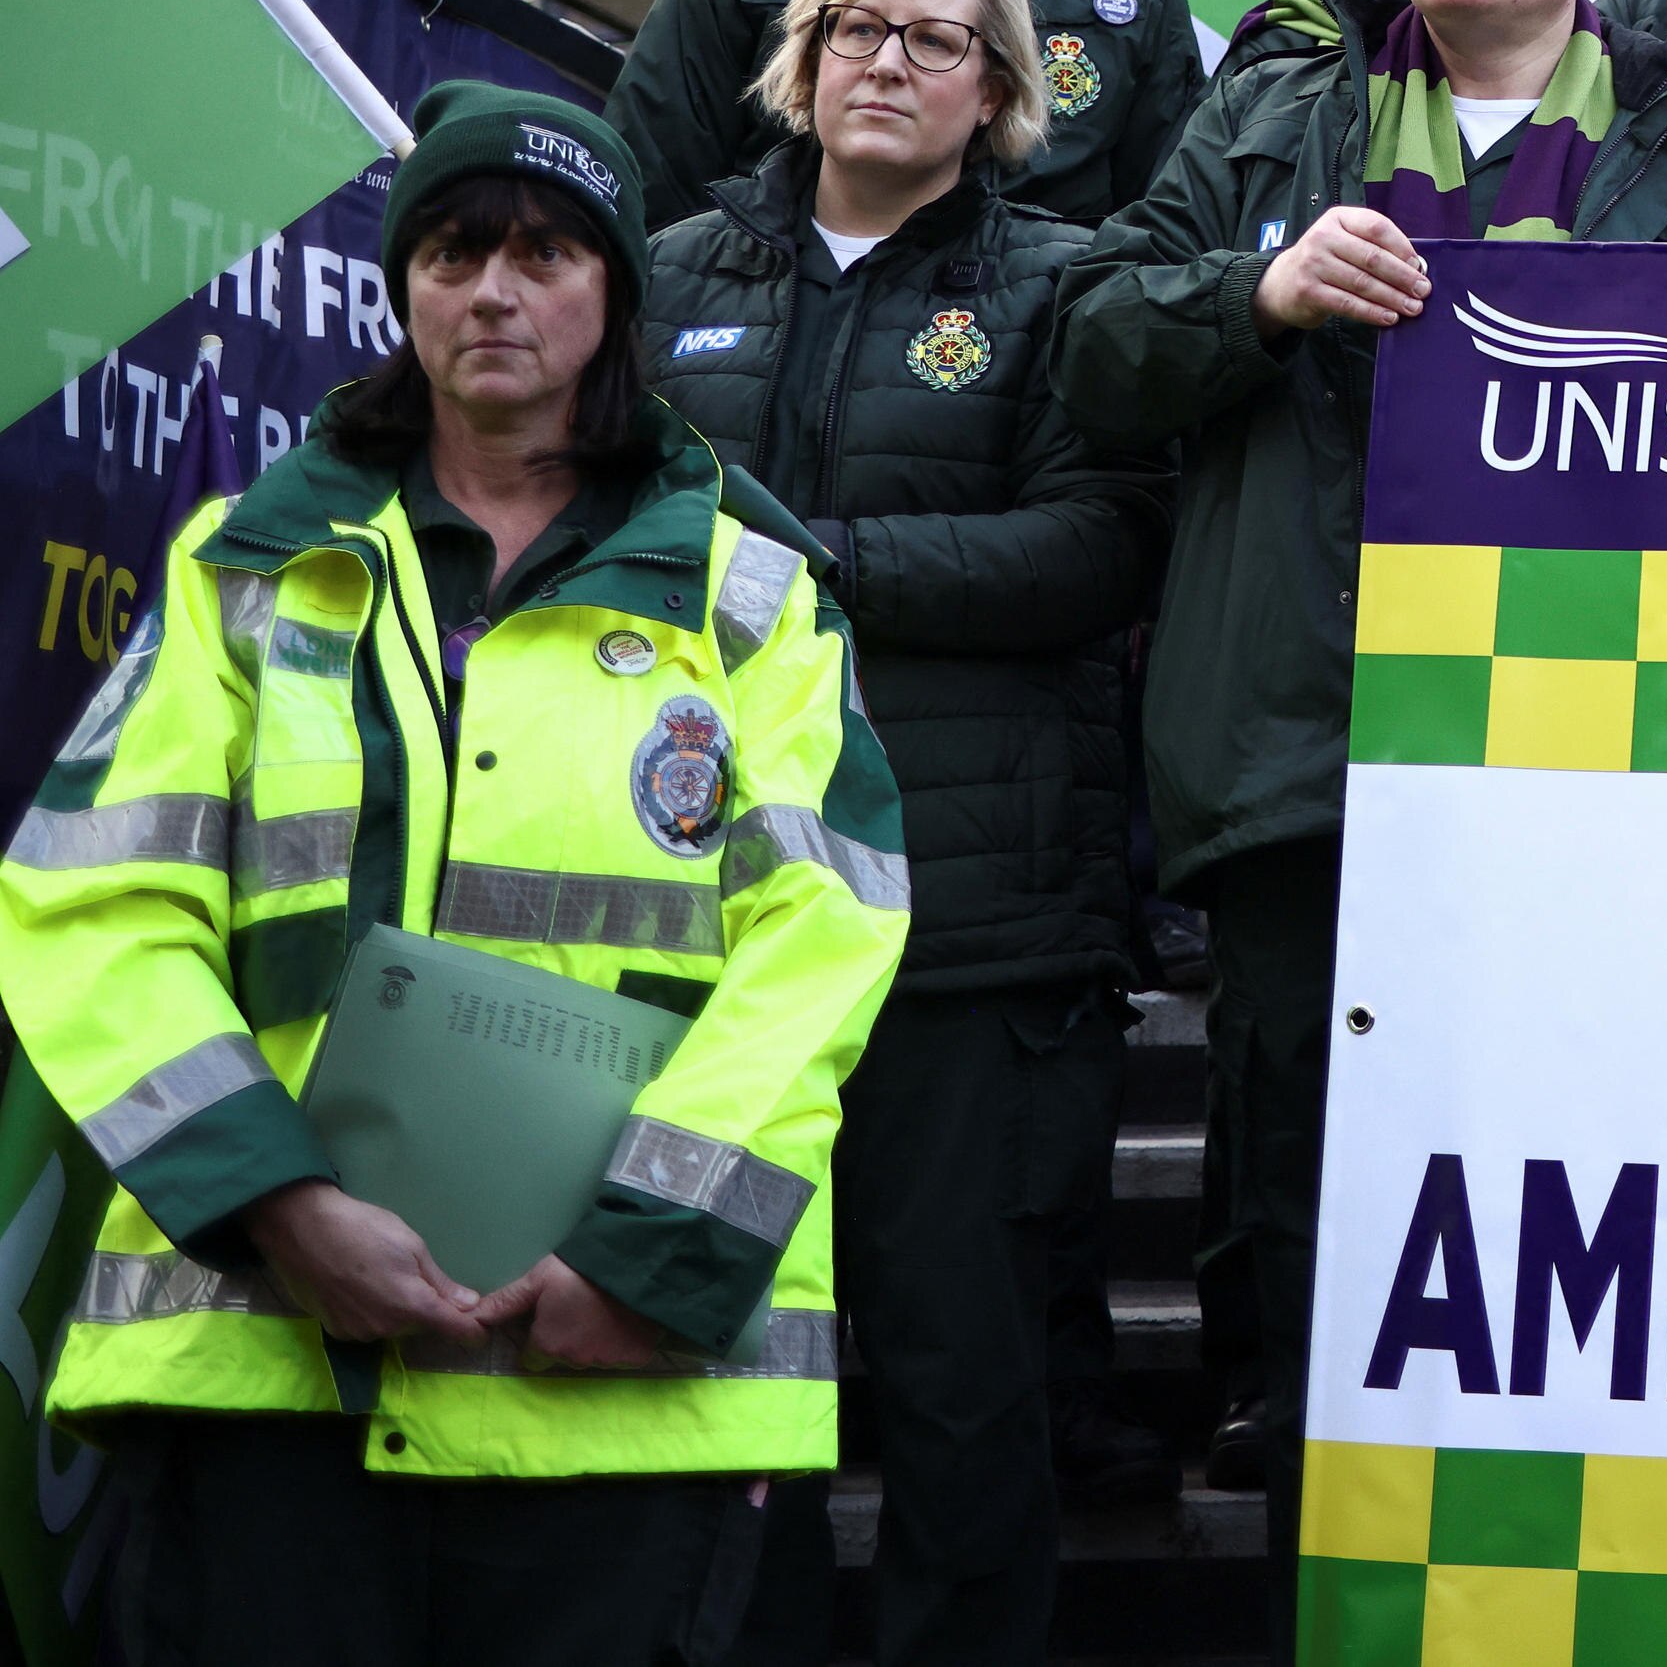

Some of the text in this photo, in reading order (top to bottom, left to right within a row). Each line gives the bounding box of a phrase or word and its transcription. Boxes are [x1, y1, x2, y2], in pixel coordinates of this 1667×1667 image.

[527, 133, 622, 197] UNISON
[677, 328, 743, 355] NHS
[926, 333, 970, 351] AMBULANCE
